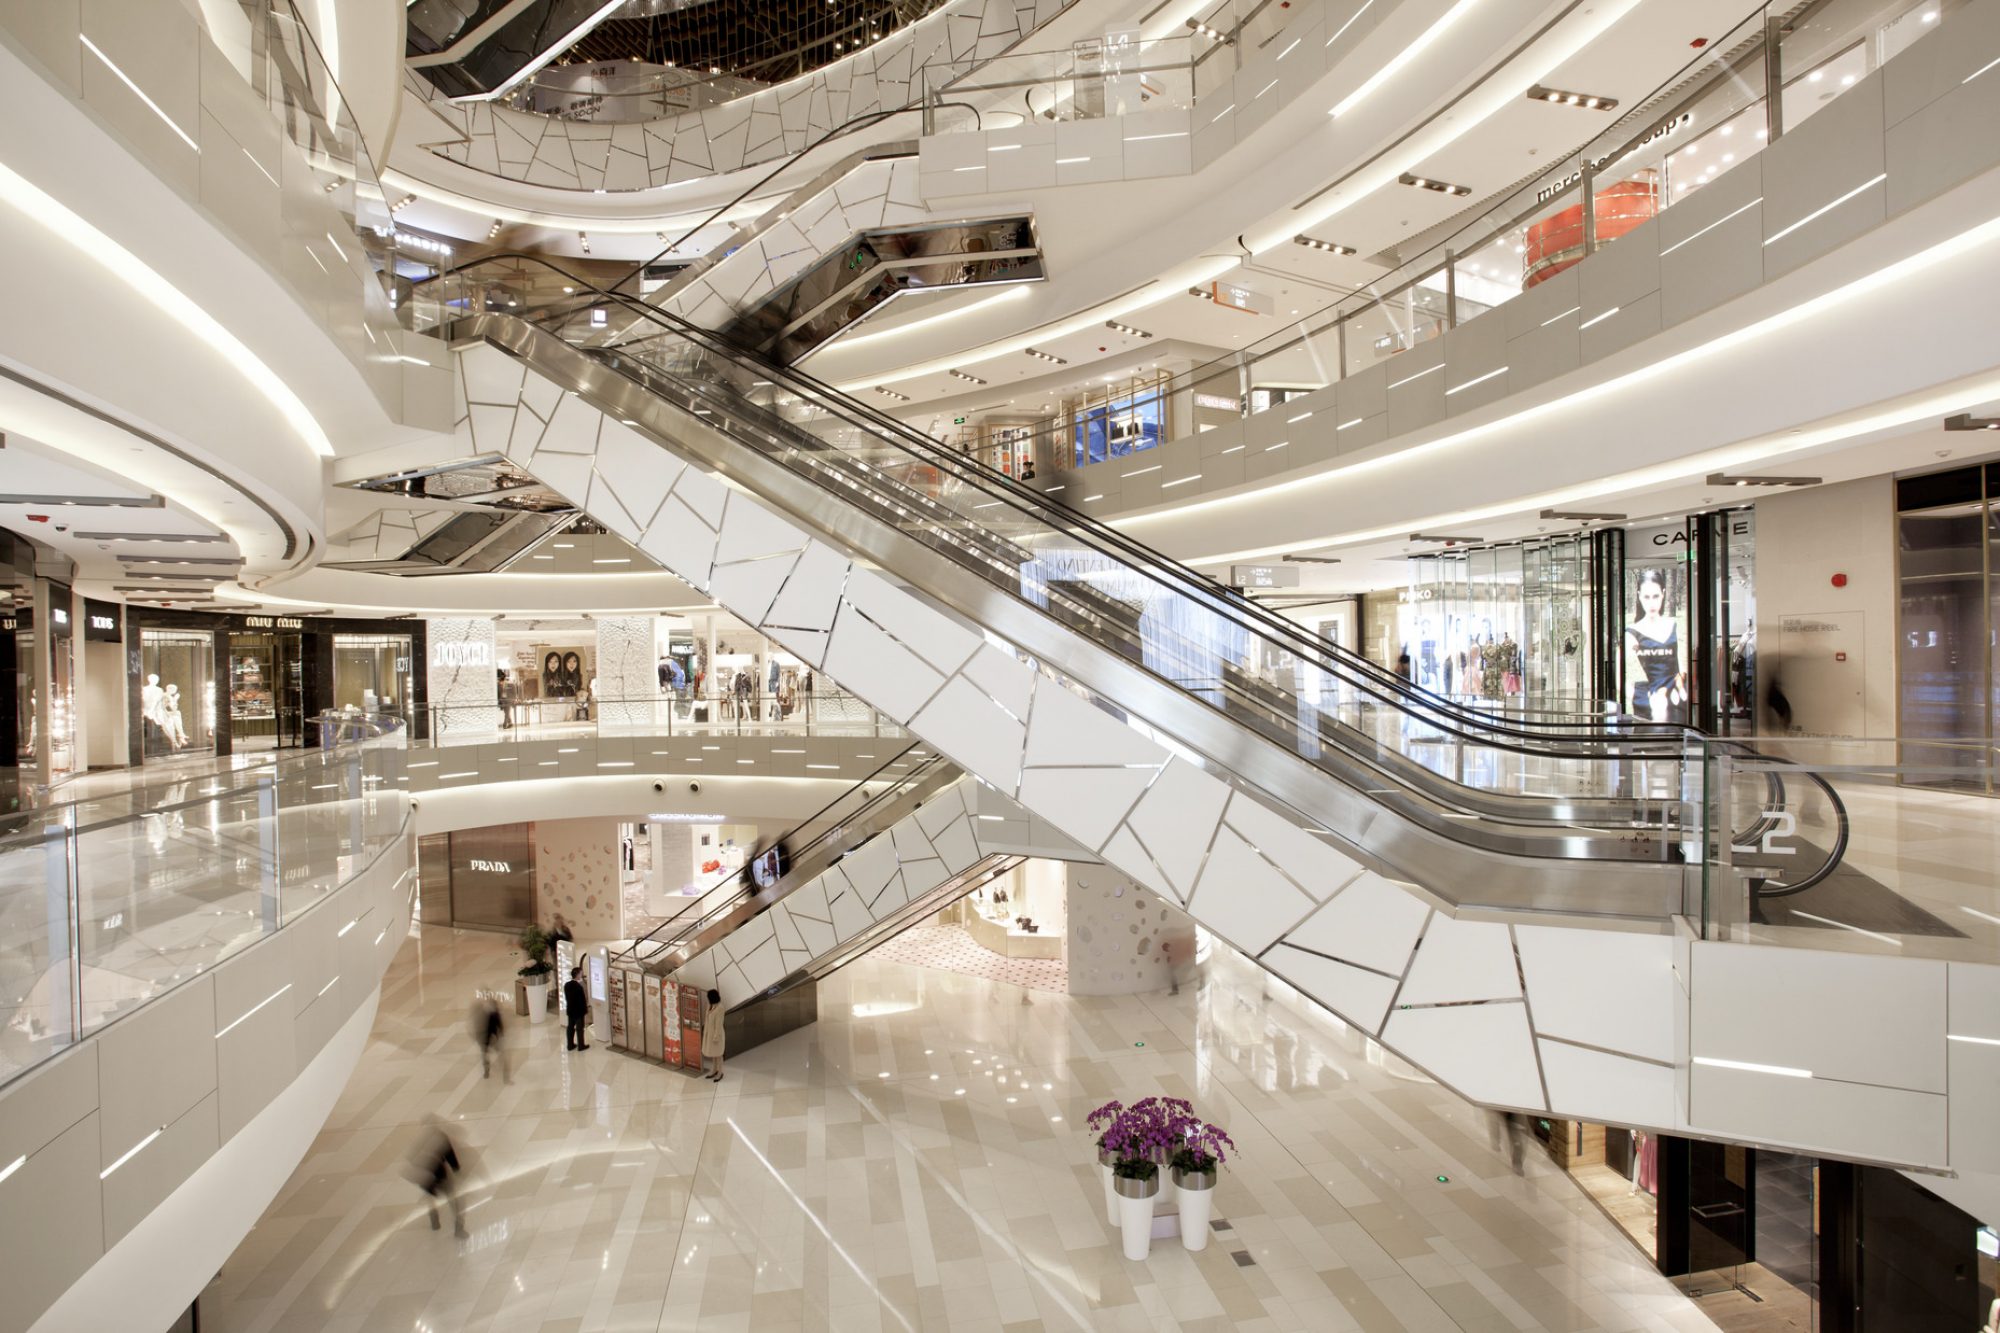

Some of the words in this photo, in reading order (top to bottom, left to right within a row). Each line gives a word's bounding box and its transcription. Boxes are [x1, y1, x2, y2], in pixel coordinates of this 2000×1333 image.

[1399, 589, 1432, 602] PIKO
[1636, 648, 1673, 656] ARVEN
[470, 860, 511, 872] PRADA
